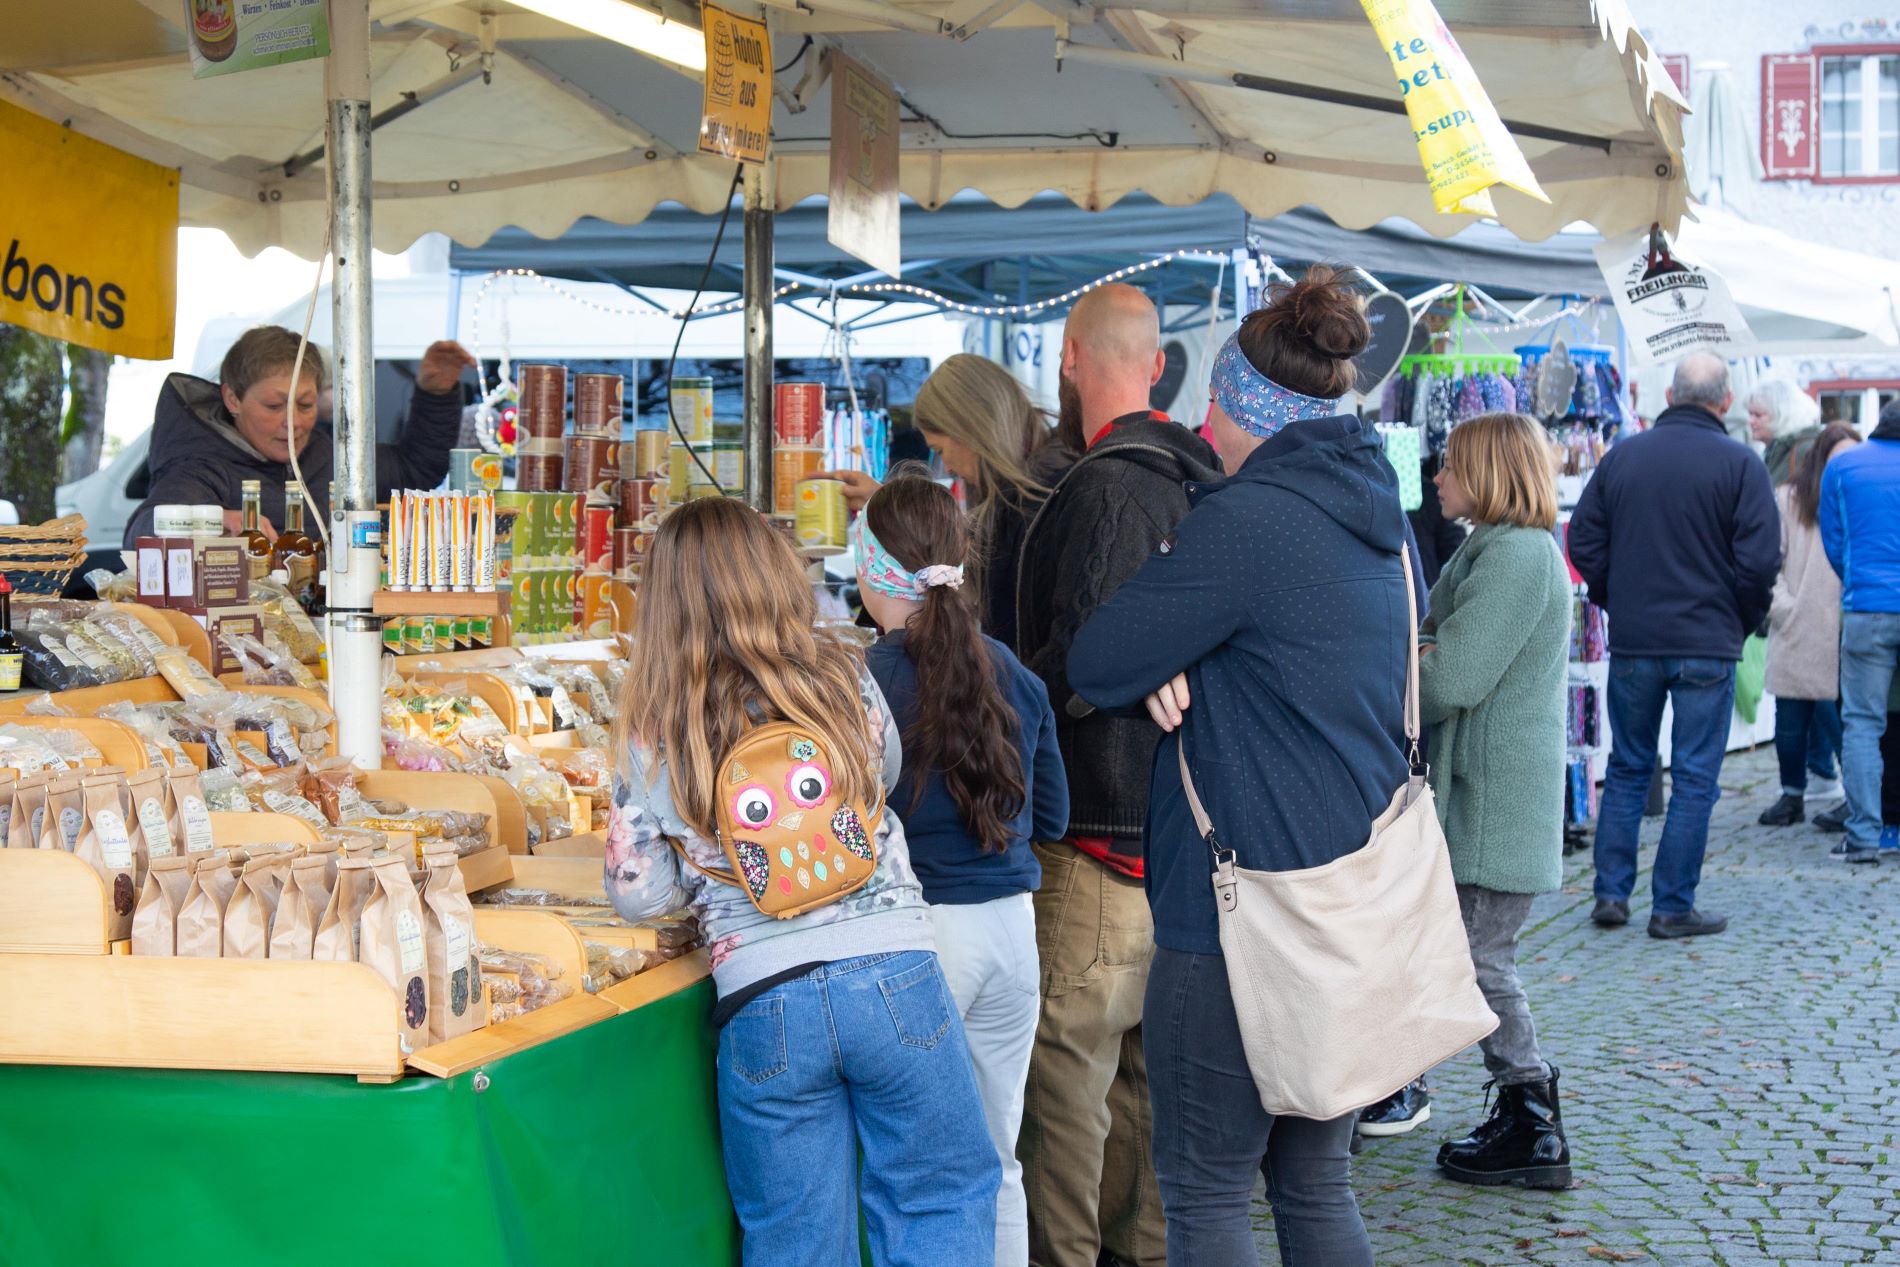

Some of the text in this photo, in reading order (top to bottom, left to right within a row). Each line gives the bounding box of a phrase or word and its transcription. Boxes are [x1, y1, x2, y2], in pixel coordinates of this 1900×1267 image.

[731, 22, 764, 74] Honig
[739, 79, 757, 108] aus
[0, 239, 126, 330] bons
[1626, 274, 1709, 300] FREILINGER
